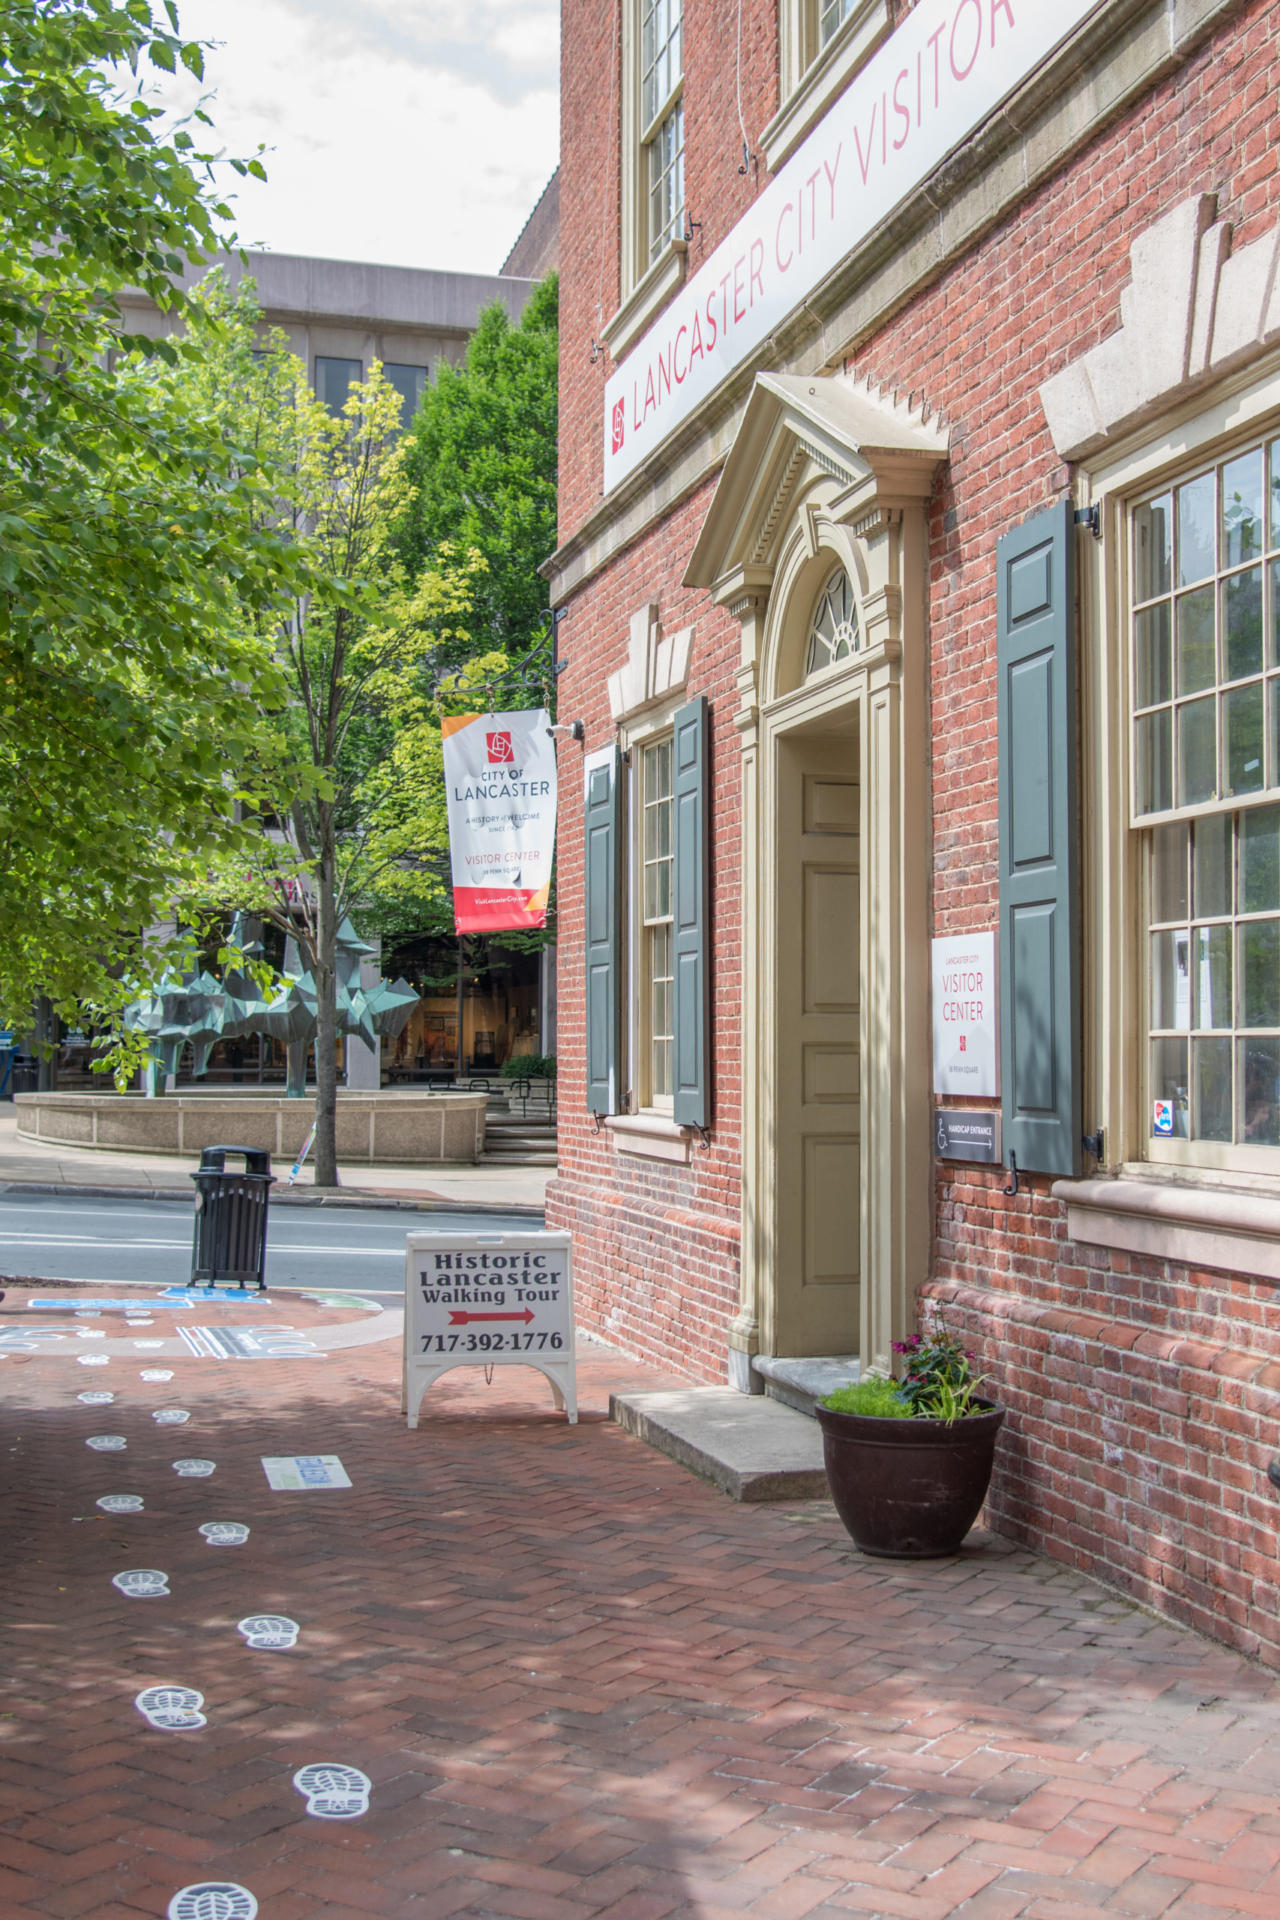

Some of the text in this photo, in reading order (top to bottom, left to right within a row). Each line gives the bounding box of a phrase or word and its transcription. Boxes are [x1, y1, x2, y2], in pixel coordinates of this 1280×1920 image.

[632, 236, 765, 432] LANCASTER
[774, 142, 843, 274] CITY
[481, 769, 524, 782] CITY OF
[454, 781, 550, 802] LANCASTER
[465, 850, 541, 865] VISITOR CENTER
[942, 972, 983, 993] VISITOR
[942, 1001, 983, 1022] CENTER
[948, 1124, 993, 1136] HANDICAP ENTRANCE
[434, 1252, 546, 1270] Historic
[420, 1269, 562, 1287] Lancaster
[422, 1288, 560, 1306] Walking Tour
[420, 1331, 563, 1353] 717-392-1776
